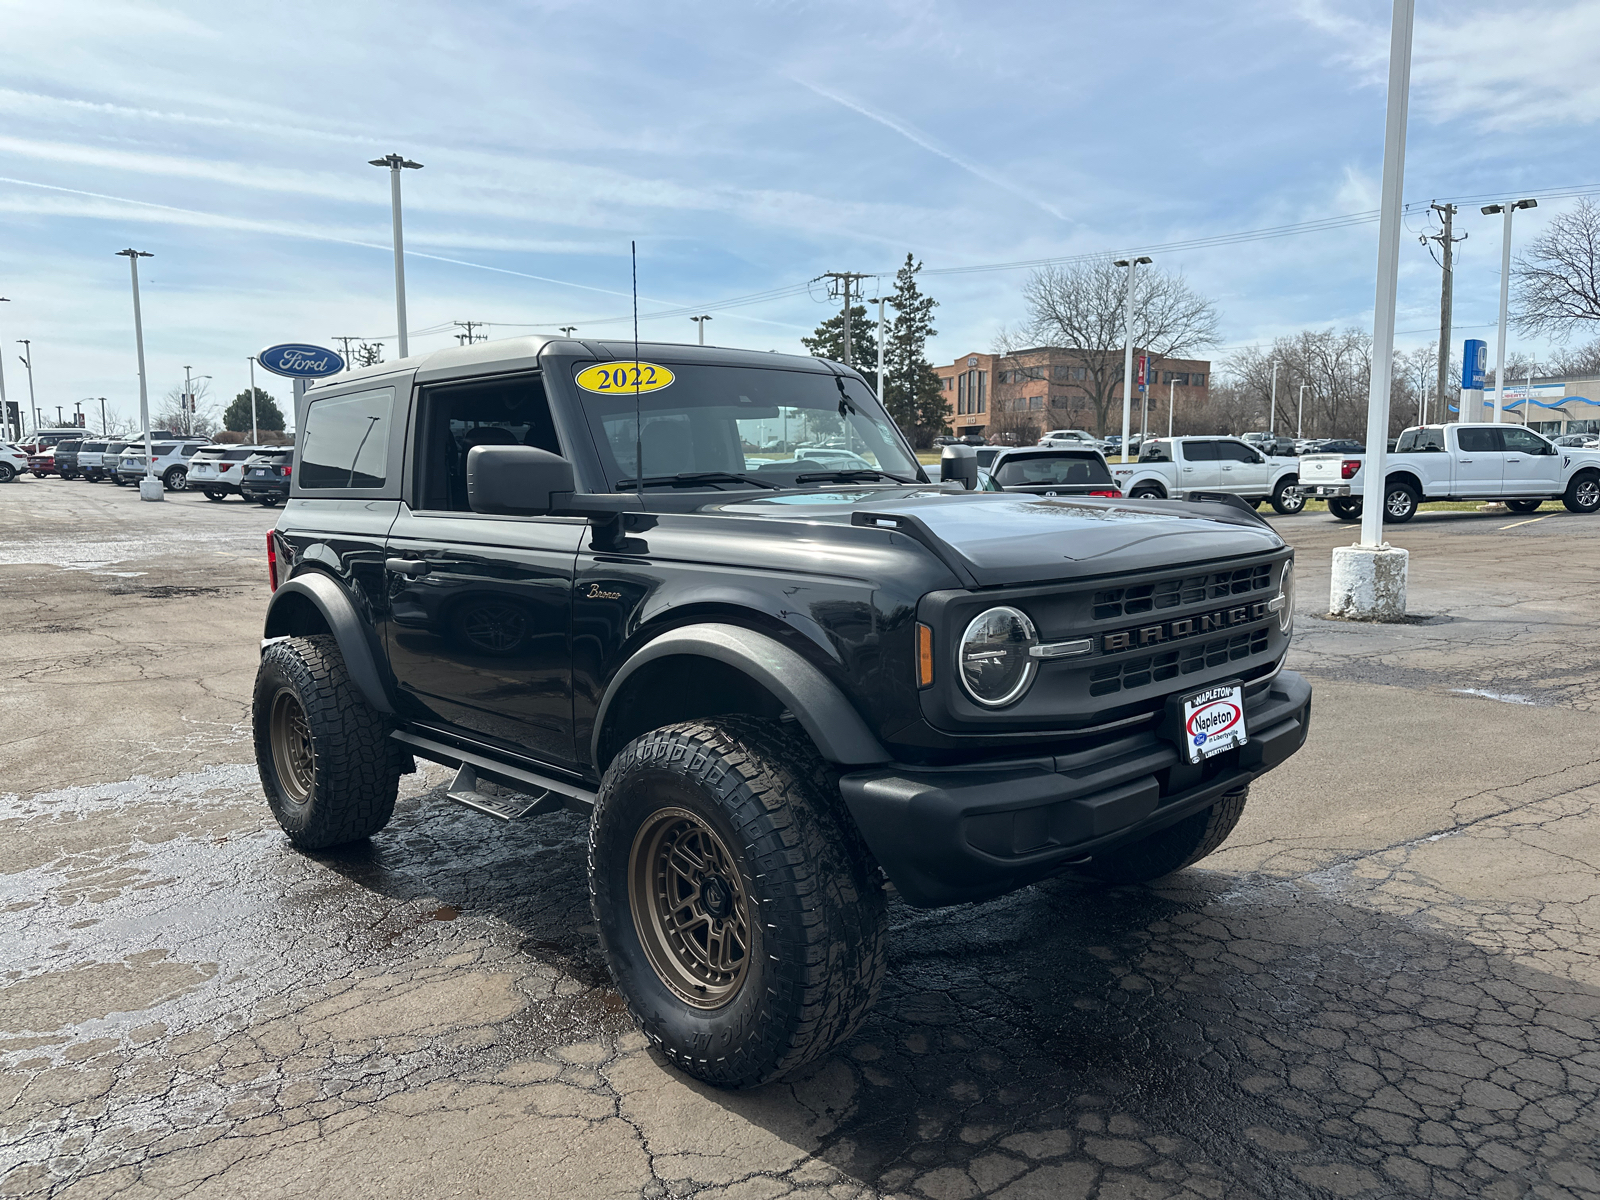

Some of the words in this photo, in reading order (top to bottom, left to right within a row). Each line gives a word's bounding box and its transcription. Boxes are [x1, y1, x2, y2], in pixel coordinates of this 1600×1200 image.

[279, 349, 328, 371] Ford
[596, 366, 657, 389] 2022
[586, 583, 621, 599] Bronco
[1104, 601, 1269, 651] BRONCO
[1196, 687, 1231, 706] NAPLETON
[1195, 711, 1232, 732] Napleton
[1213, 729, 1239, 742] Libertyville
[1205, 743, 1235, 758] LIBERTYVILLE
